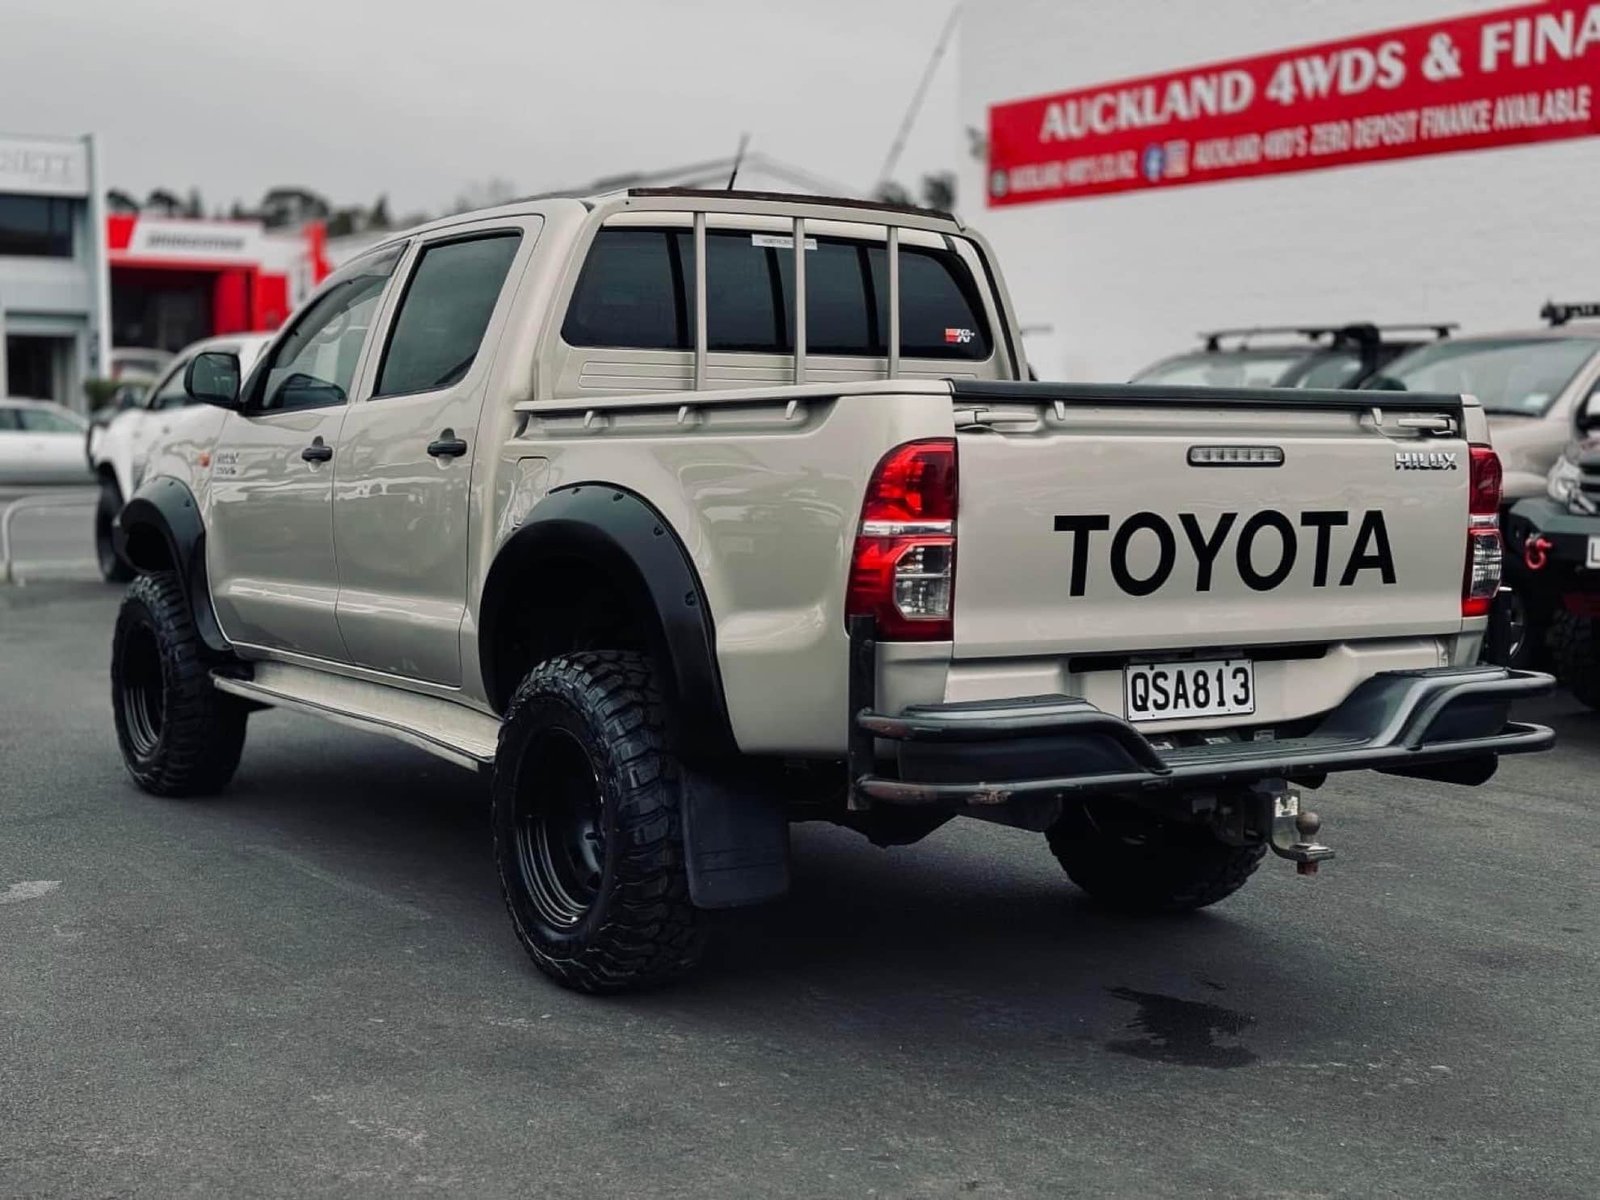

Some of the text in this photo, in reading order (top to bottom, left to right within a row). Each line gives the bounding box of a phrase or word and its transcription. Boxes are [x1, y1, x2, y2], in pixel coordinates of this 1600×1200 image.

[1039, 70, 1256, 142] AUCKLAND
[1265, 41, 1406, 105] 4WDS
[1421, 32, 1462, 82] &
[1352, 110, 1418, 150] DEPOSIT
[1420, 99, 1491, 140] FINANCE
[1493, 85, 1591, 131] AVAILABLE
[1395, 452, 1457, 470] HILUX
[1053, 510, 1397, 597] TOYOTA
[1131, 667, 1250, 712] QSA813
